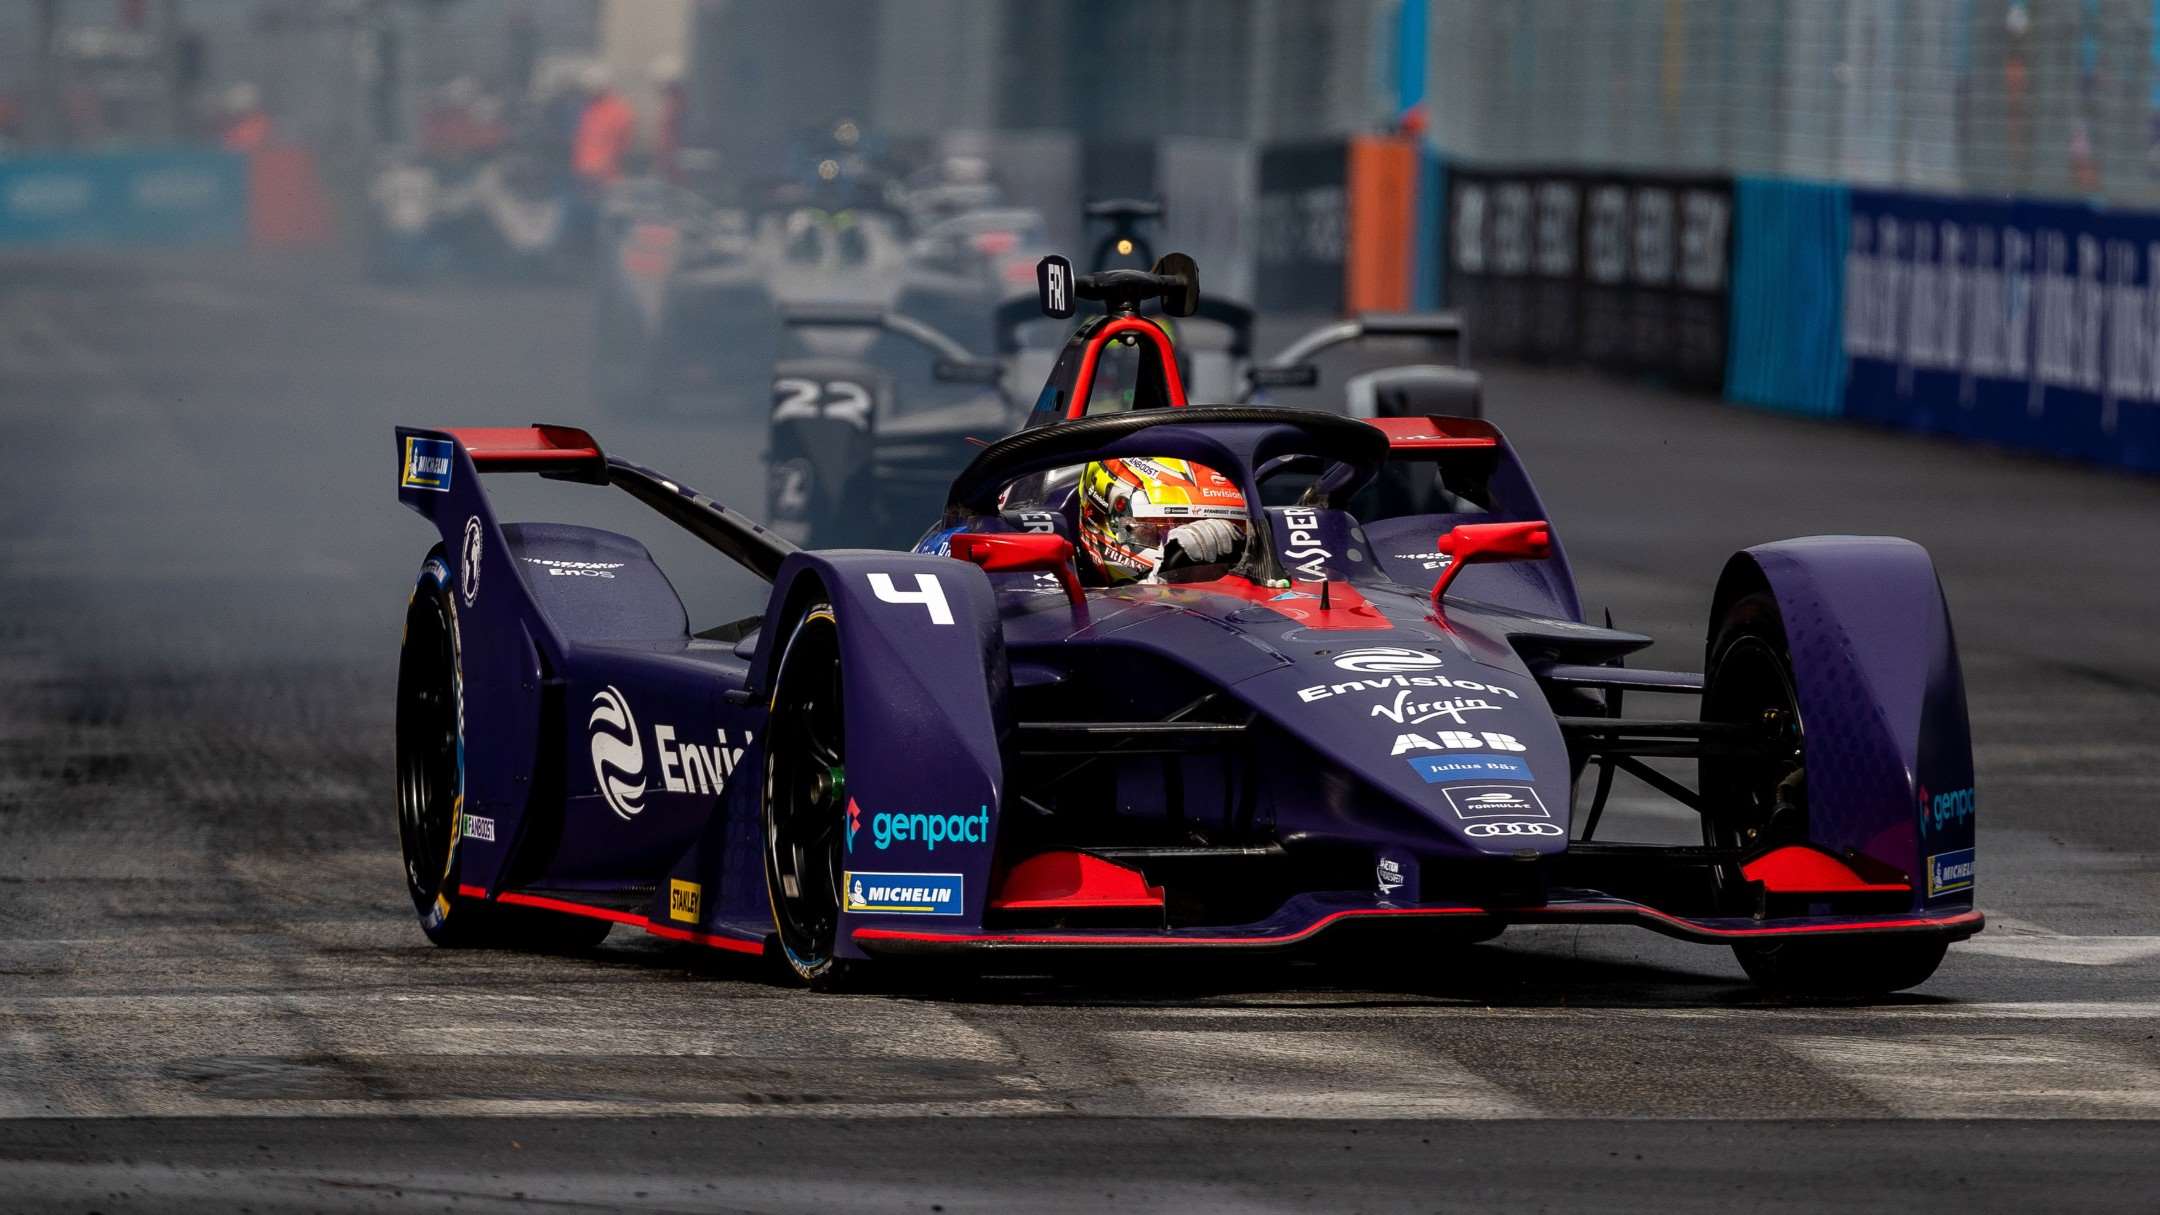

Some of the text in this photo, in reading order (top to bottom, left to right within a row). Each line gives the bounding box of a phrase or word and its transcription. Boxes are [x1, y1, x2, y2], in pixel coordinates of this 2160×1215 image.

[1048, 263, 1065, 311] FRI
[418, 457, 449, 475] MICHELIN
[1203, 488, 1244, 501] Envision
[866, 573, 955, 625] 4
[1297, 675, 1519, 703] Envision
[1371, 690, 1503, 725] Virgin
[1391, 731, 1527, 755] ABB
[654, 724, 753, 796] Envi
[873, 805, 989, 851] genpact
[672, 888, 699, 913] STANLEY
[868, 887, 951, 903] MICHELIN
